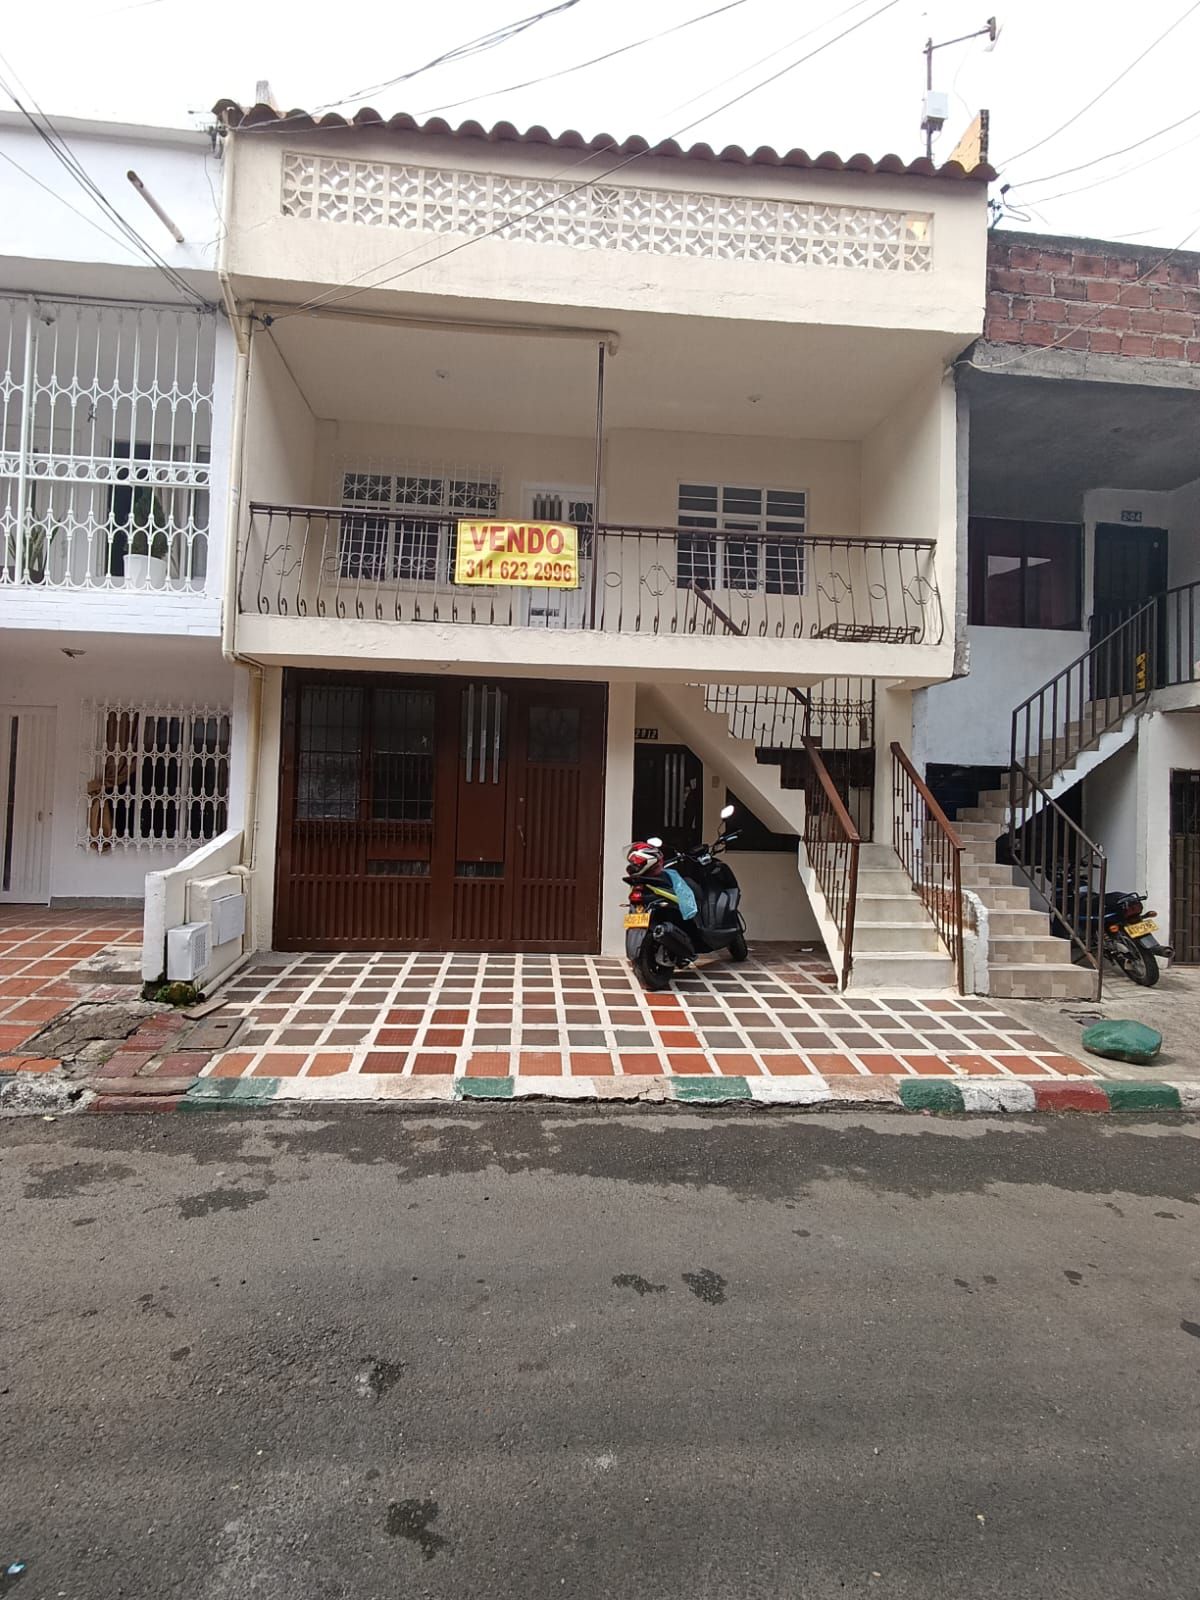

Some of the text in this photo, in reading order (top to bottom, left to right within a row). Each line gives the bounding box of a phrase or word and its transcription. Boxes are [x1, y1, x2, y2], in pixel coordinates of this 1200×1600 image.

[470, 525, 564, 554] VENDO
[466, 559, 572, 581] 311 623 2996
